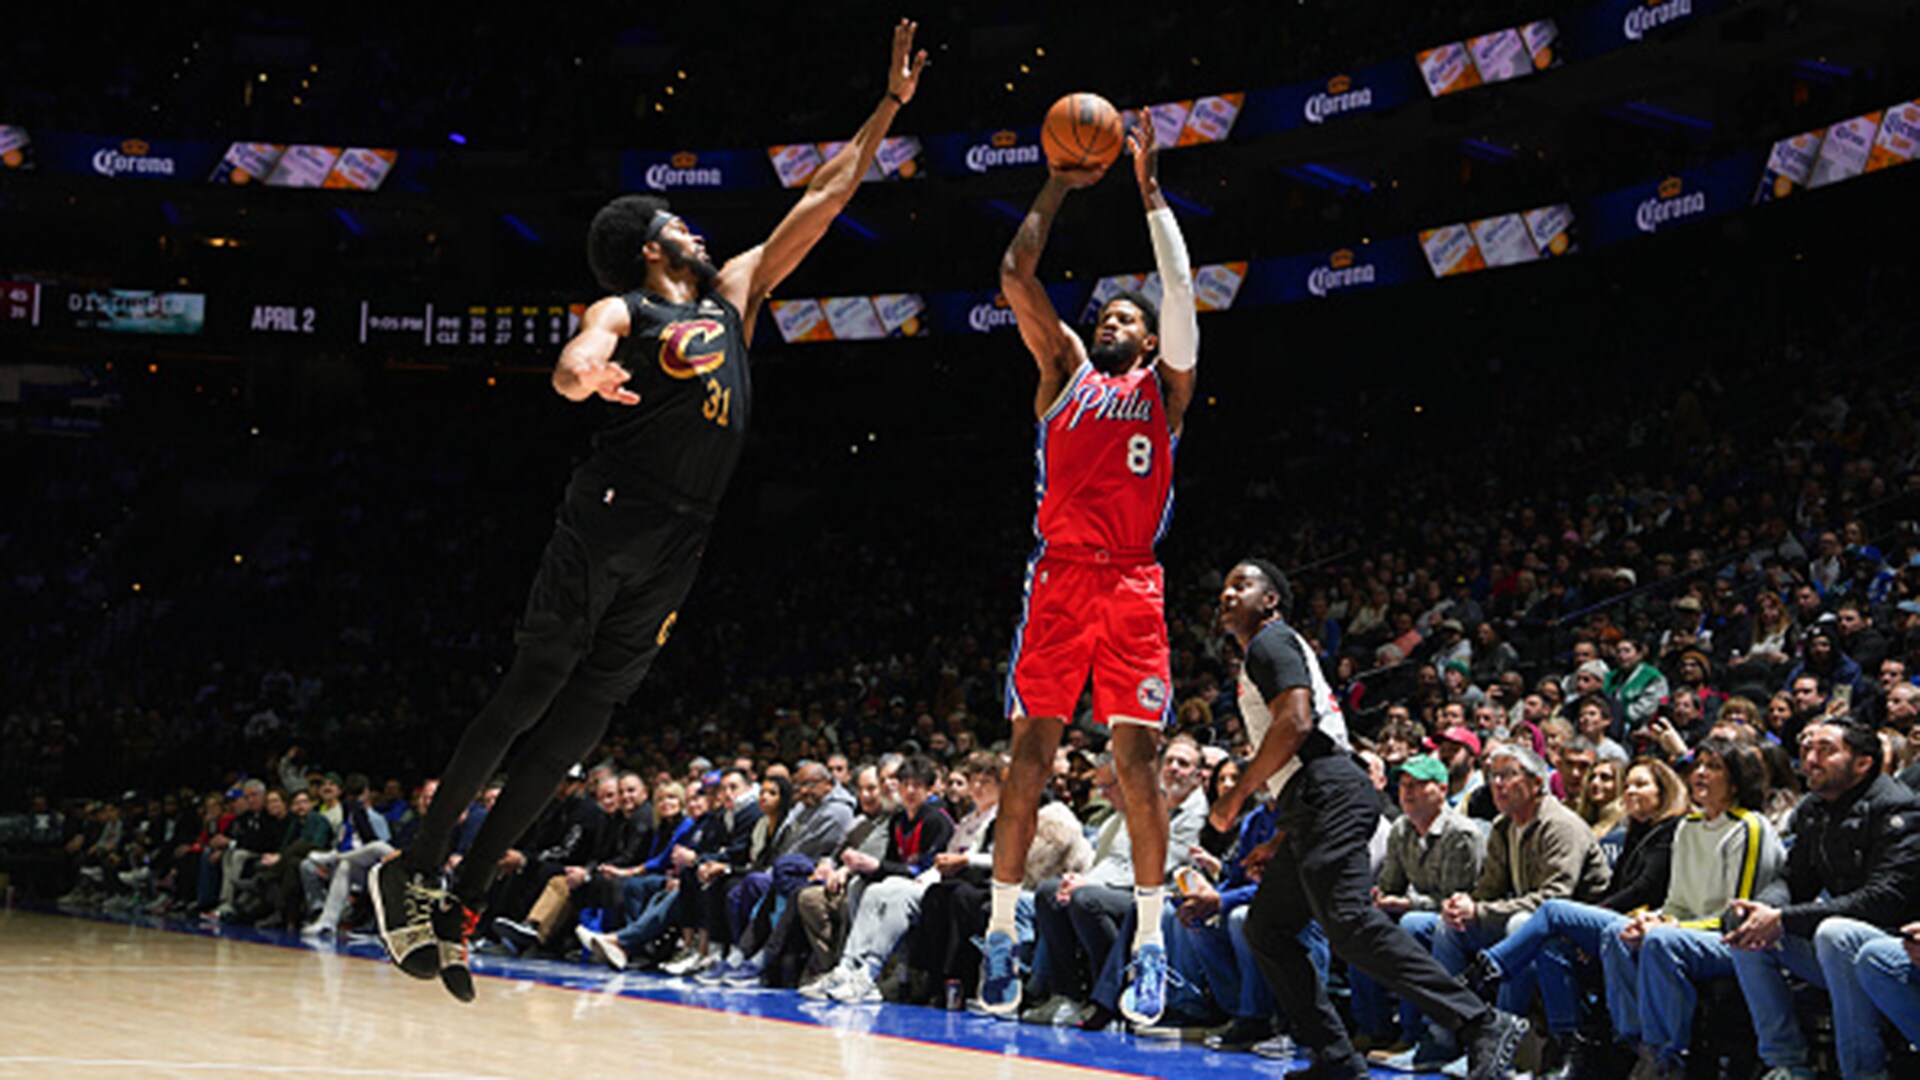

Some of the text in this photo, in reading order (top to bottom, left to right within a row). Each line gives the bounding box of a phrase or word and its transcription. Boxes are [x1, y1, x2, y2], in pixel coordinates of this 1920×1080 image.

[1624, 0, 1691, 39] Corona
[1304, 87, 1371, 122] Corona
[92, 149, 174, 176] Corona
[966, 143, 1039, 171] Corona
[645, 164, 721, 190] Corona
[1636, 192, 1705, 231] Corona
[1307, 262, 1375, 296] Corona
[251, 306, 315, 332] APRIL 2
[369, 316, 423, 330] 9:05 PM
[436, 332, 459, 344] CLE
[495, 332, 512, 344] 27
[702, 378, 731, 427] 31
[1067, 384, 1153, 430] Phila
[1127, 433, 1154, 478] 8
